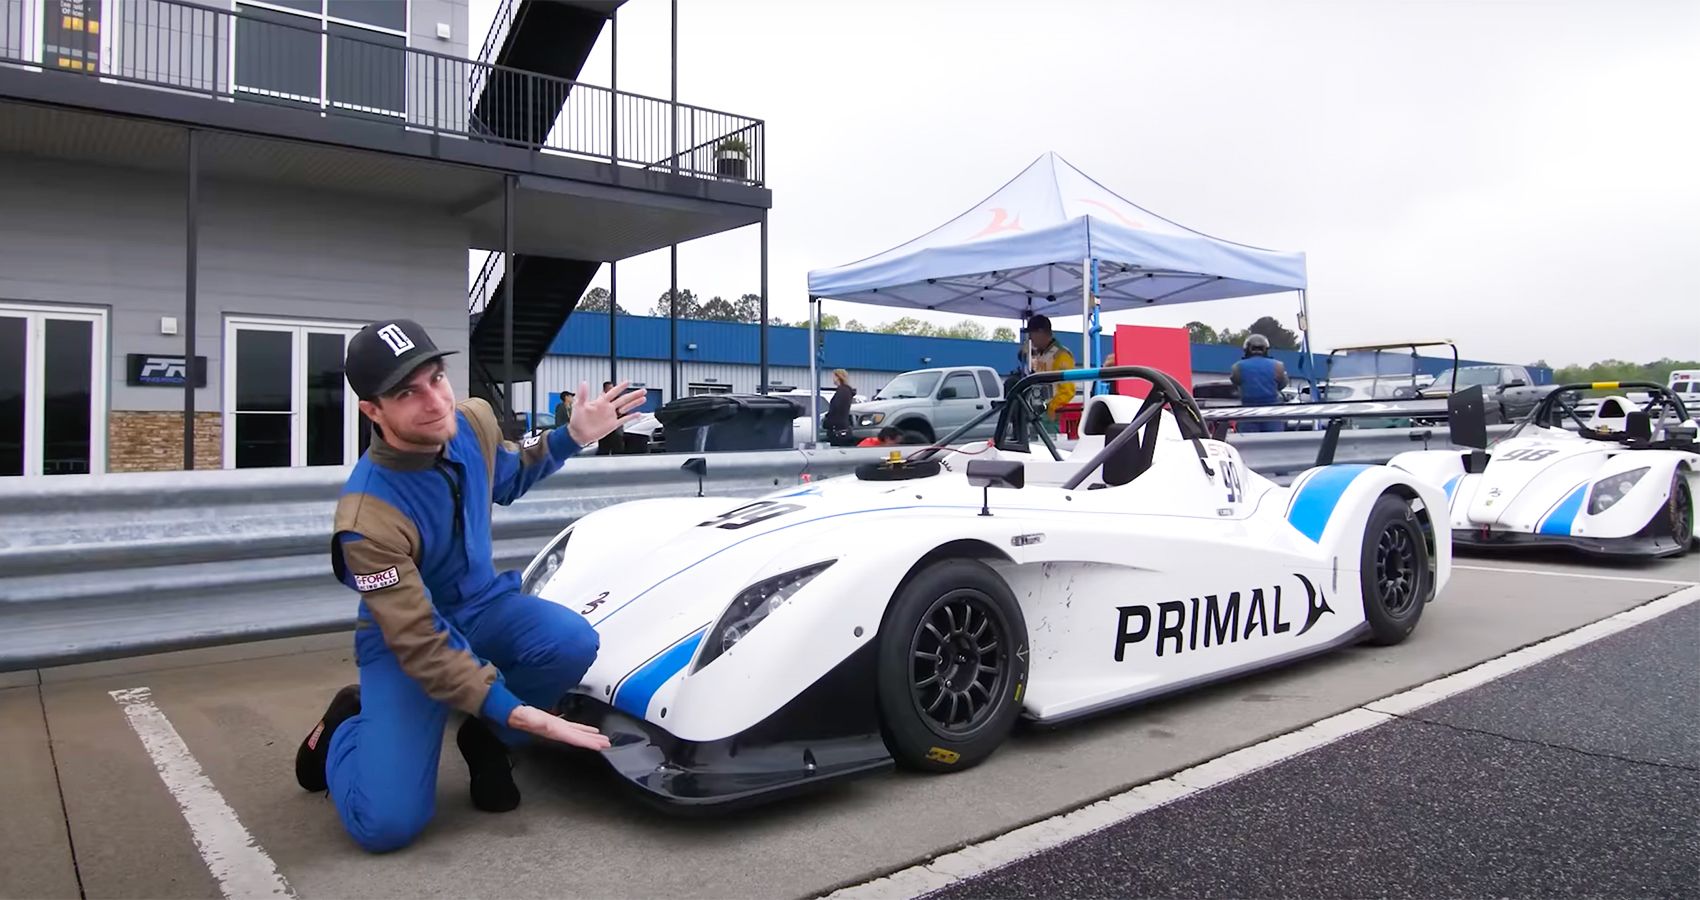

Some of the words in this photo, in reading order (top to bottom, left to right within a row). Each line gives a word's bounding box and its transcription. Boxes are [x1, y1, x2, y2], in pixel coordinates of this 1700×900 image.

[1495, 449, 1560, 461] 98
[1219, 460, 1243, 503] 99
[696, 501, 807, 530] 99
[1114, 585, 1291, 662] PRIMAL
